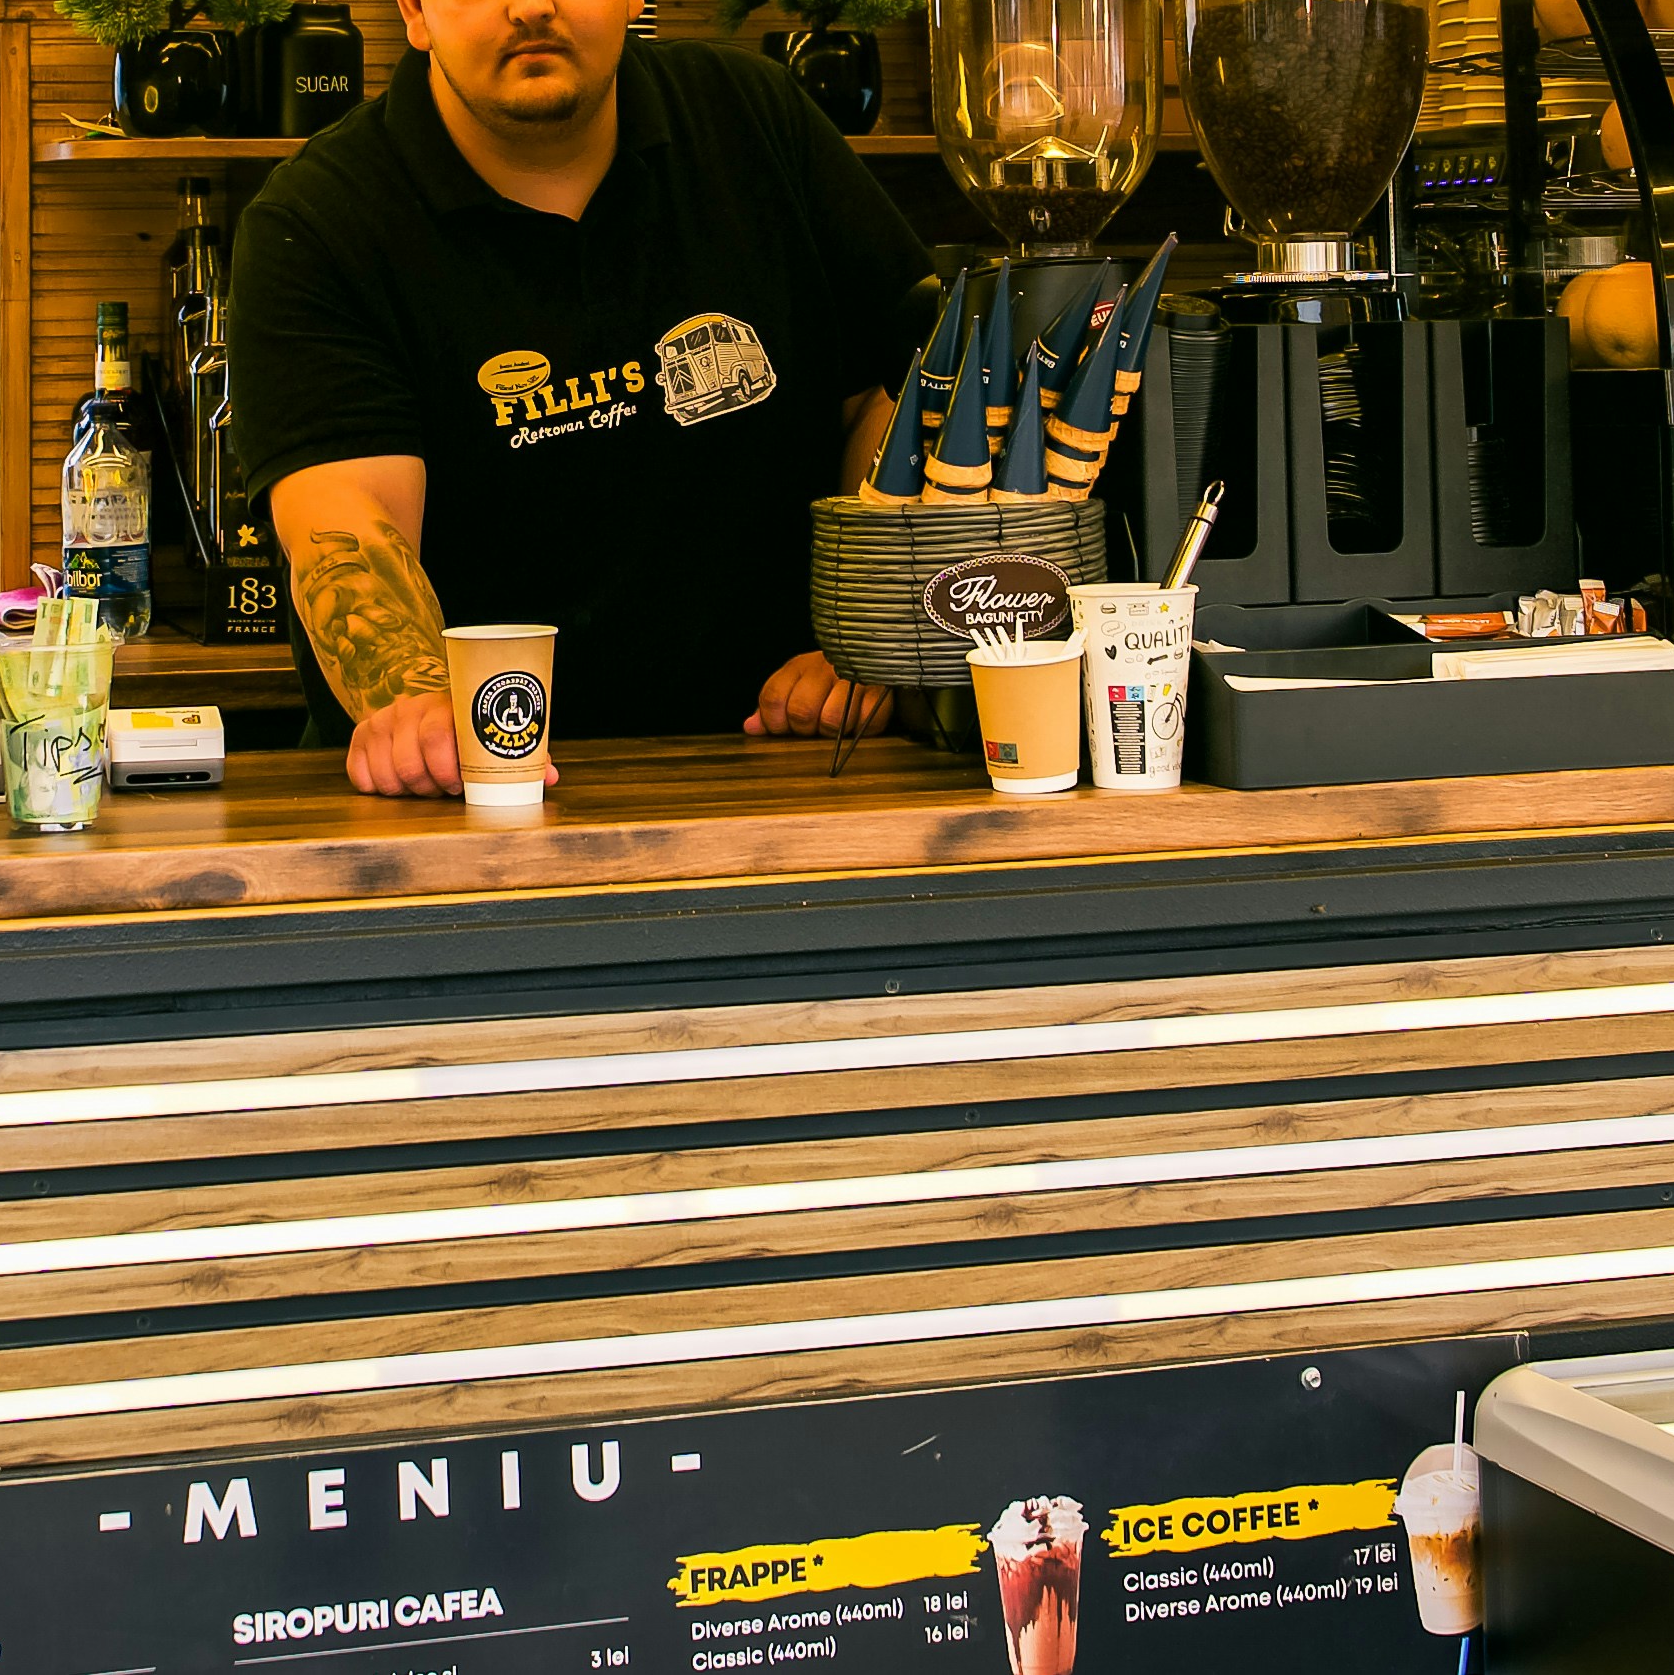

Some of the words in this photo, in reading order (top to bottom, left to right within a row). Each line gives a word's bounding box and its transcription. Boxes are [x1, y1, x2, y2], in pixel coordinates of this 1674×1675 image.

[295, 75, 349, 94] SUGAR
[490, 361, 645, 426] FILLI'S
[510, 420, 585, 448] Retrovan
[588, 401, 638, 429] Coffee
[66, 569, 103, 588] bilbor
[949, 574, 1056, 612] Flower
[10, 714, 93, 773] Tips
[1123, 1514, 1174, 1545] ICE
[1181, 1500, 1301, 1538] COFFEE
[690, 1556, 808, 1594] FRAPPE
[1123, 1566, 1198, 1593] Classic
[1202, 1555, 1275, 1587] (440ml)
[1353, 1546, 1371, 1567] 17
[1374, 1543, 1397, 1564] lei
[232, 1598, 389, 1646] SIROPURI
[393, 1587, 505, 1627] CAFEA
[691, 1617, 765, 1641] Diverse
[767, 1607, 832, 1633] Arome
[835, 1596, 905, 1627] (440ml)
[923, 1594, 941, 1614] 18
[945, 1590, 968, 1611] lei
[1125, 1596, 1201, 1623] Diverse
[1204, 1588, 1272, 1614] Arome
[1276, 1576, 1348, 1608] (440ml)
[1355, 1575, 1373, 1596] 19
[1376, 1571, 1399, 1593] lei
[590, 1649, 602, 1669] 3
[606, 1645, 630, 1667] lei
[692, 1646, 764, 1671] Classic
[767, 1635, 837, 1665] (440ml)
[925, 1625, 943, 1644] 16
[947, 1620, 969, 1641] lei
